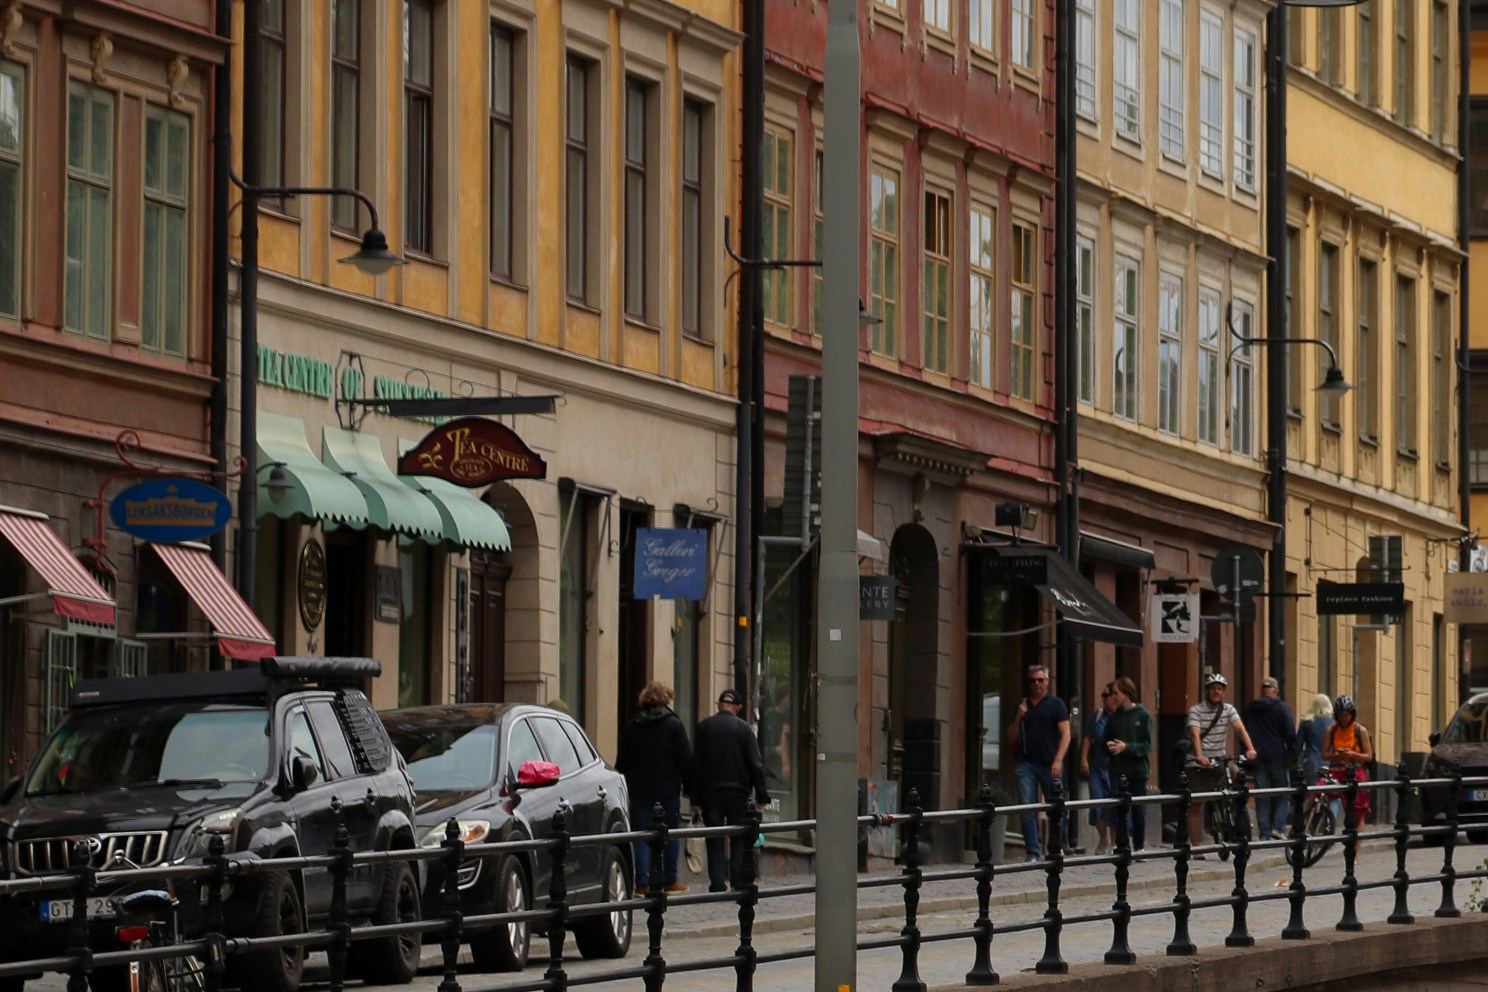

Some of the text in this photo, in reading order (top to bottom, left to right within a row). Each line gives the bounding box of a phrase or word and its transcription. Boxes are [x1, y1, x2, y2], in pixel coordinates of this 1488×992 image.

[257, 345, 283, 386] TEA
[284, 353, 331, 399] CENTRE
[342, 368, 361, 401] OF
[446, 427, 529, 472] TEA CENTRE
[50, 898, 124, 918] GT 29
